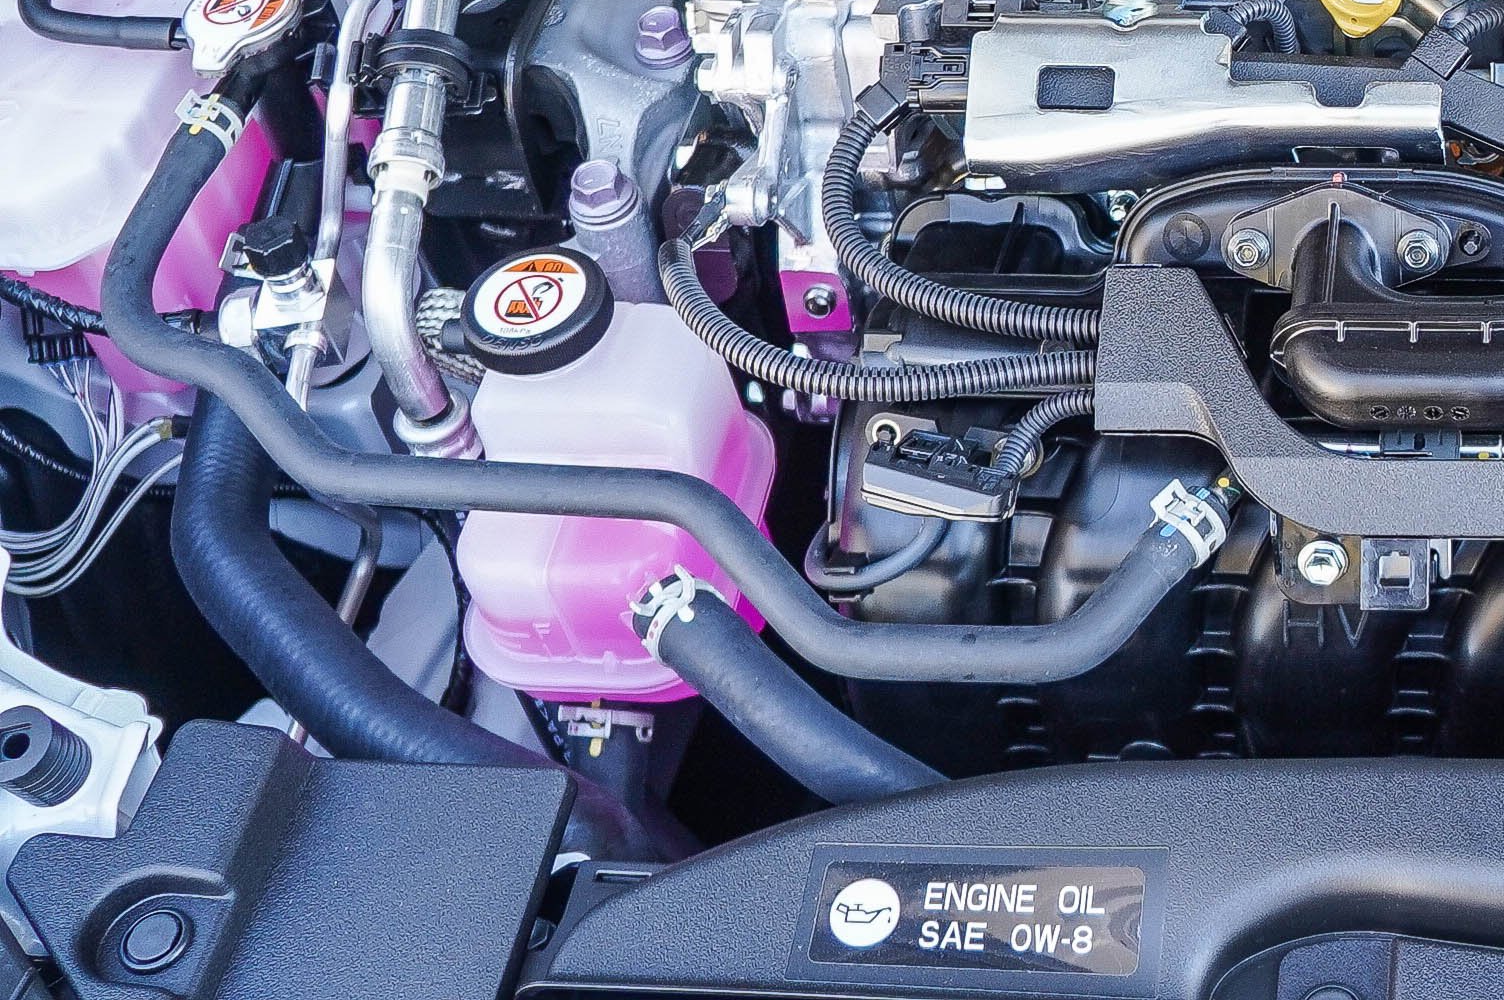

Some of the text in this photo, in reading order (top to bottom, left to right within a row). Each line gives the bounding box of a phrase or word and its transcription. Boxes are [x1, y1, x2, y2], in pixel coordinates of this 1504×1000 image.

[923, 882, 1106, 915] ENGINE OIL
[918, 920, 1094, 955] SAE 0W-8
